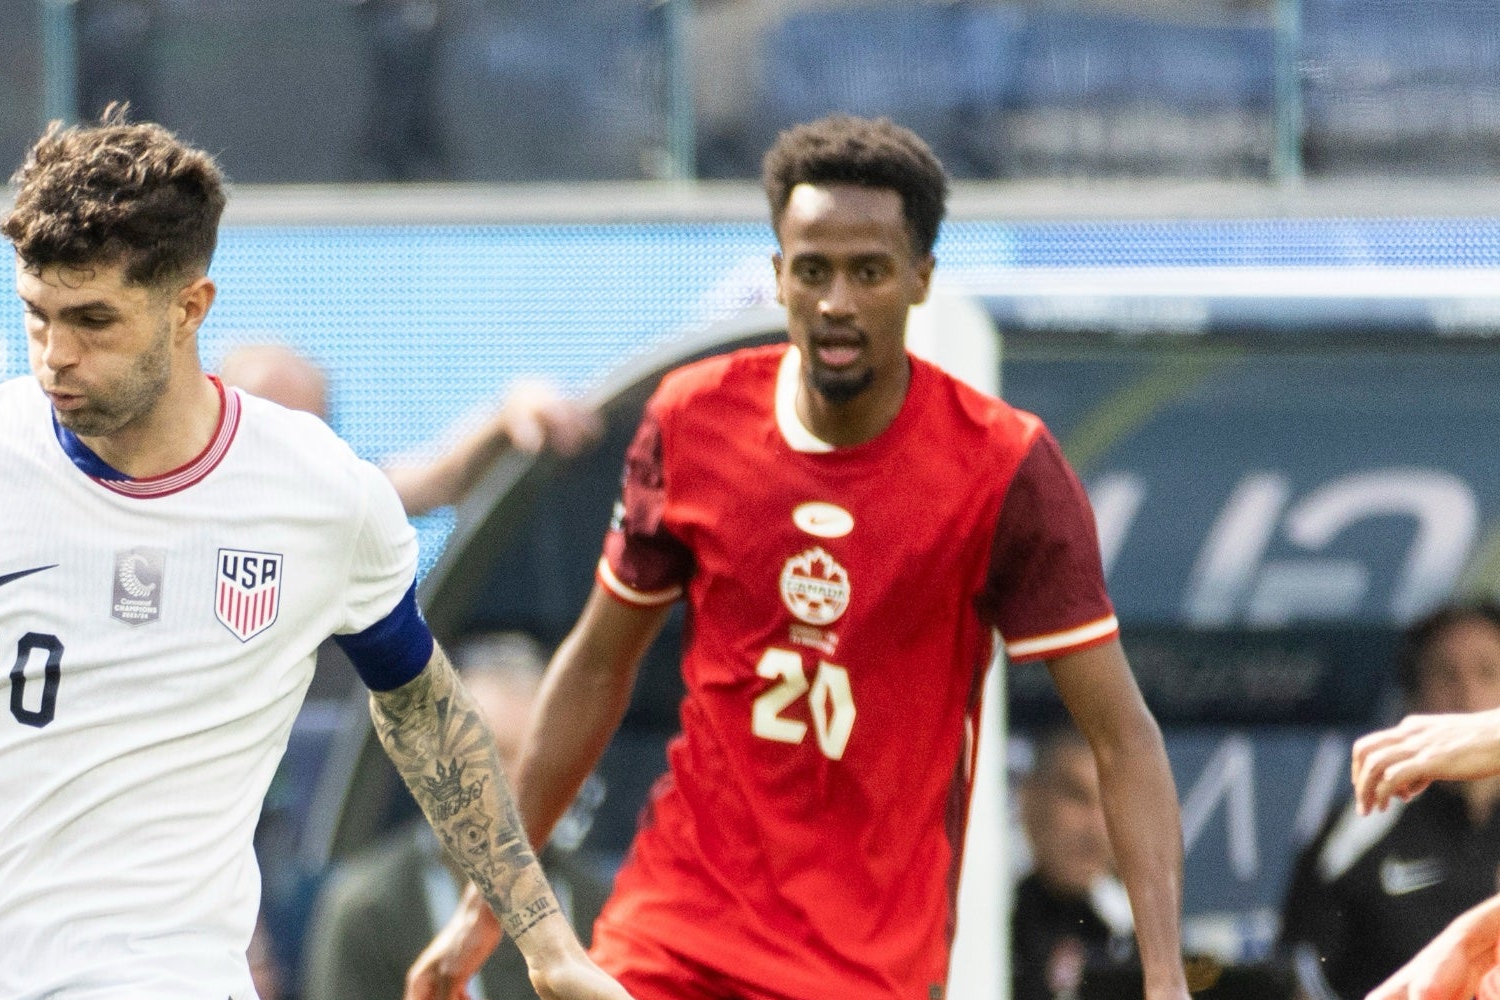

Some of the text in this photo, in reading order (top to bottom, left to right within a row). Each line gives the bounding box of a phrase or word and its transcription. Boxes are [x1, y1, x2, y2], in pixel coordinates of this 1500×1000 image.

[221, 554, 278, 590] USA
[785, 579, 846, 598] CANADA
[750, 646, 858, 761] 20
